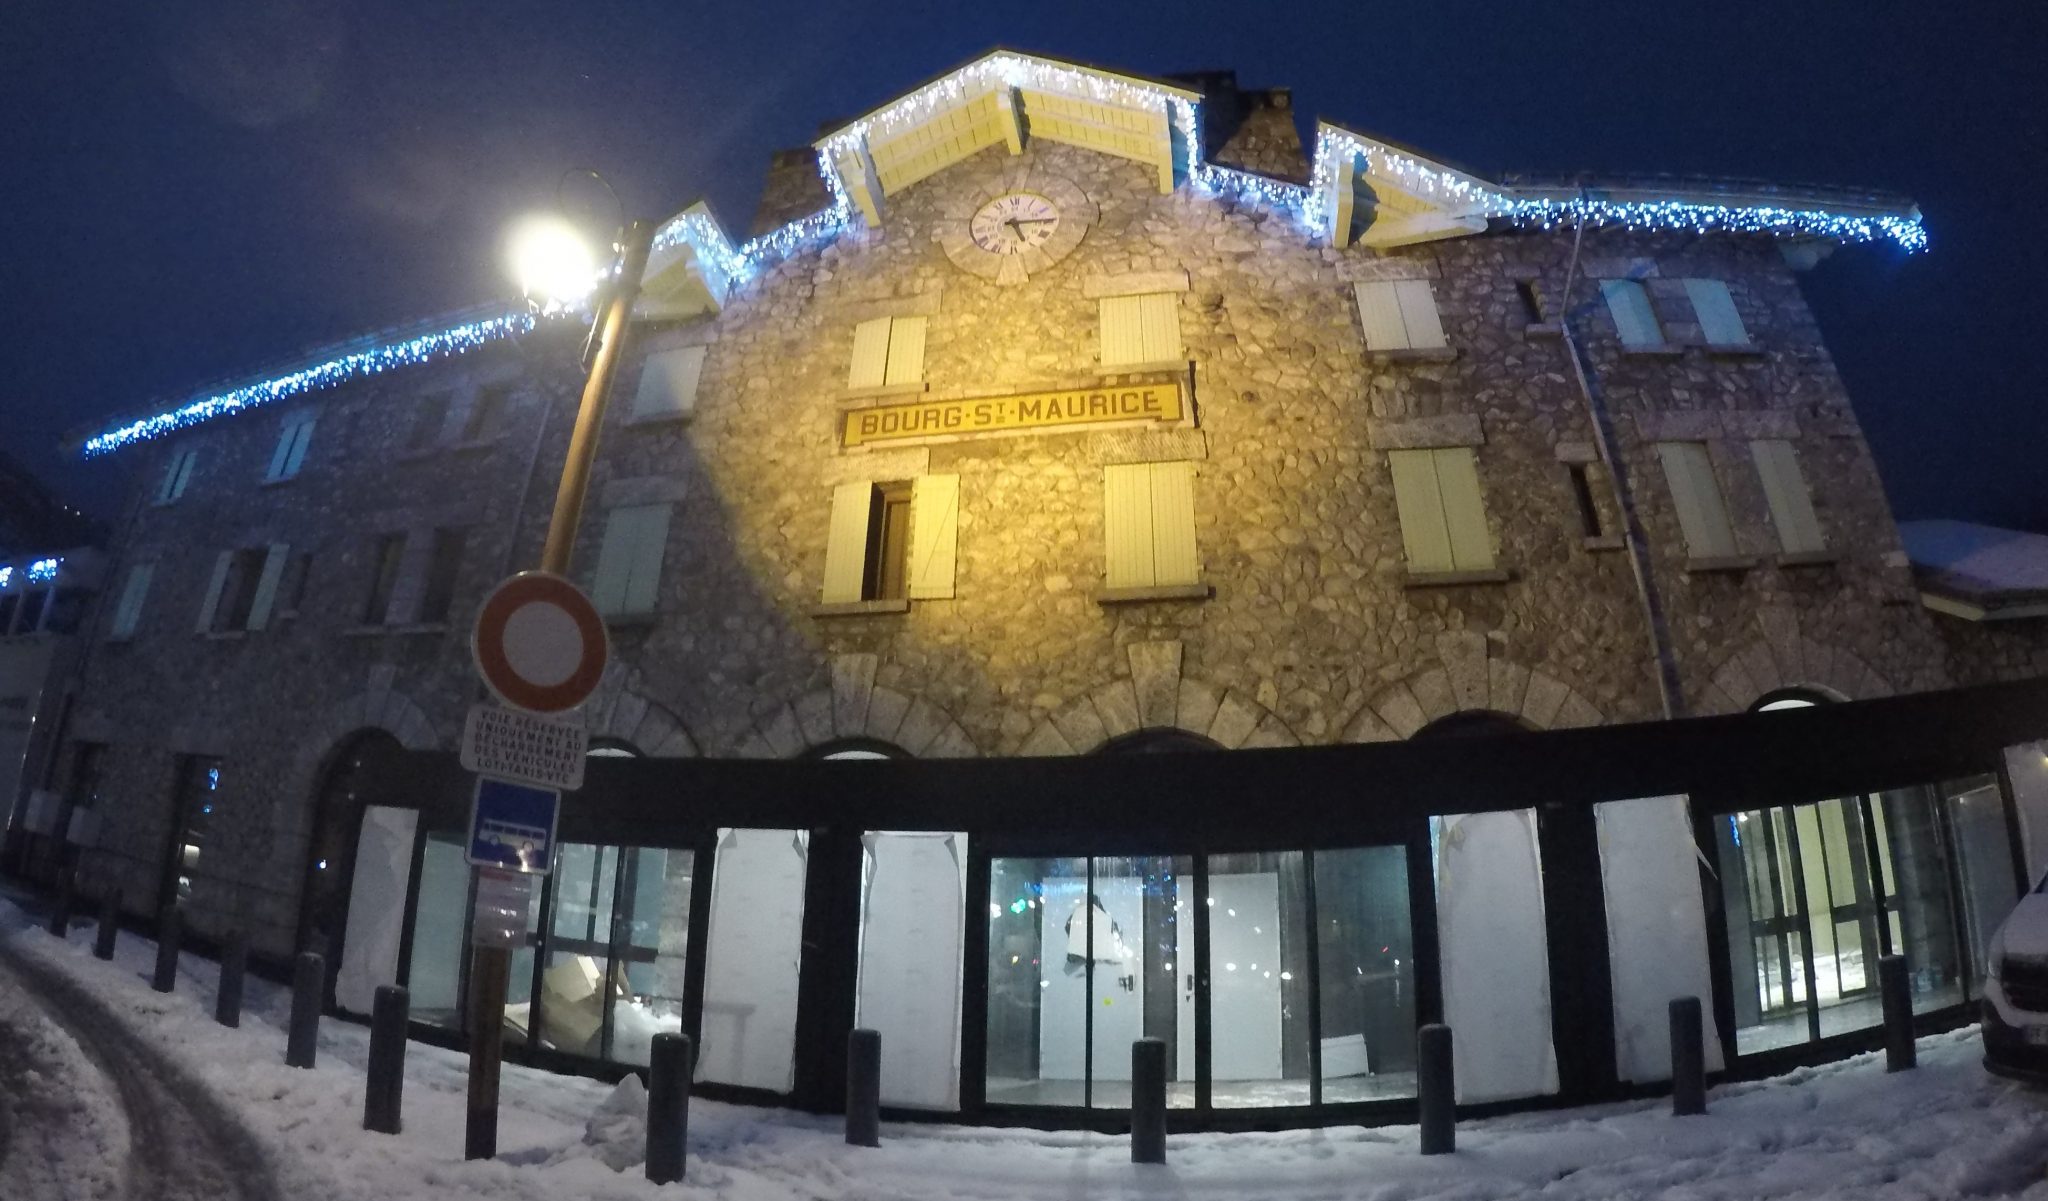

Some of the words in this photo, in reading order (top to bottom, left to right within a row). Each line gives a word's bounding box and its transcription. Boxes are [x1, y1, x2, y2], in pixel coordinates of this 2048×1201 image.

[481, 710, 511, 724] VOIE
[475, 719, 562, 747] UNIQUEMENT
[566, 739, 582, 751] AU
[474, 744, 499, 758] DES
